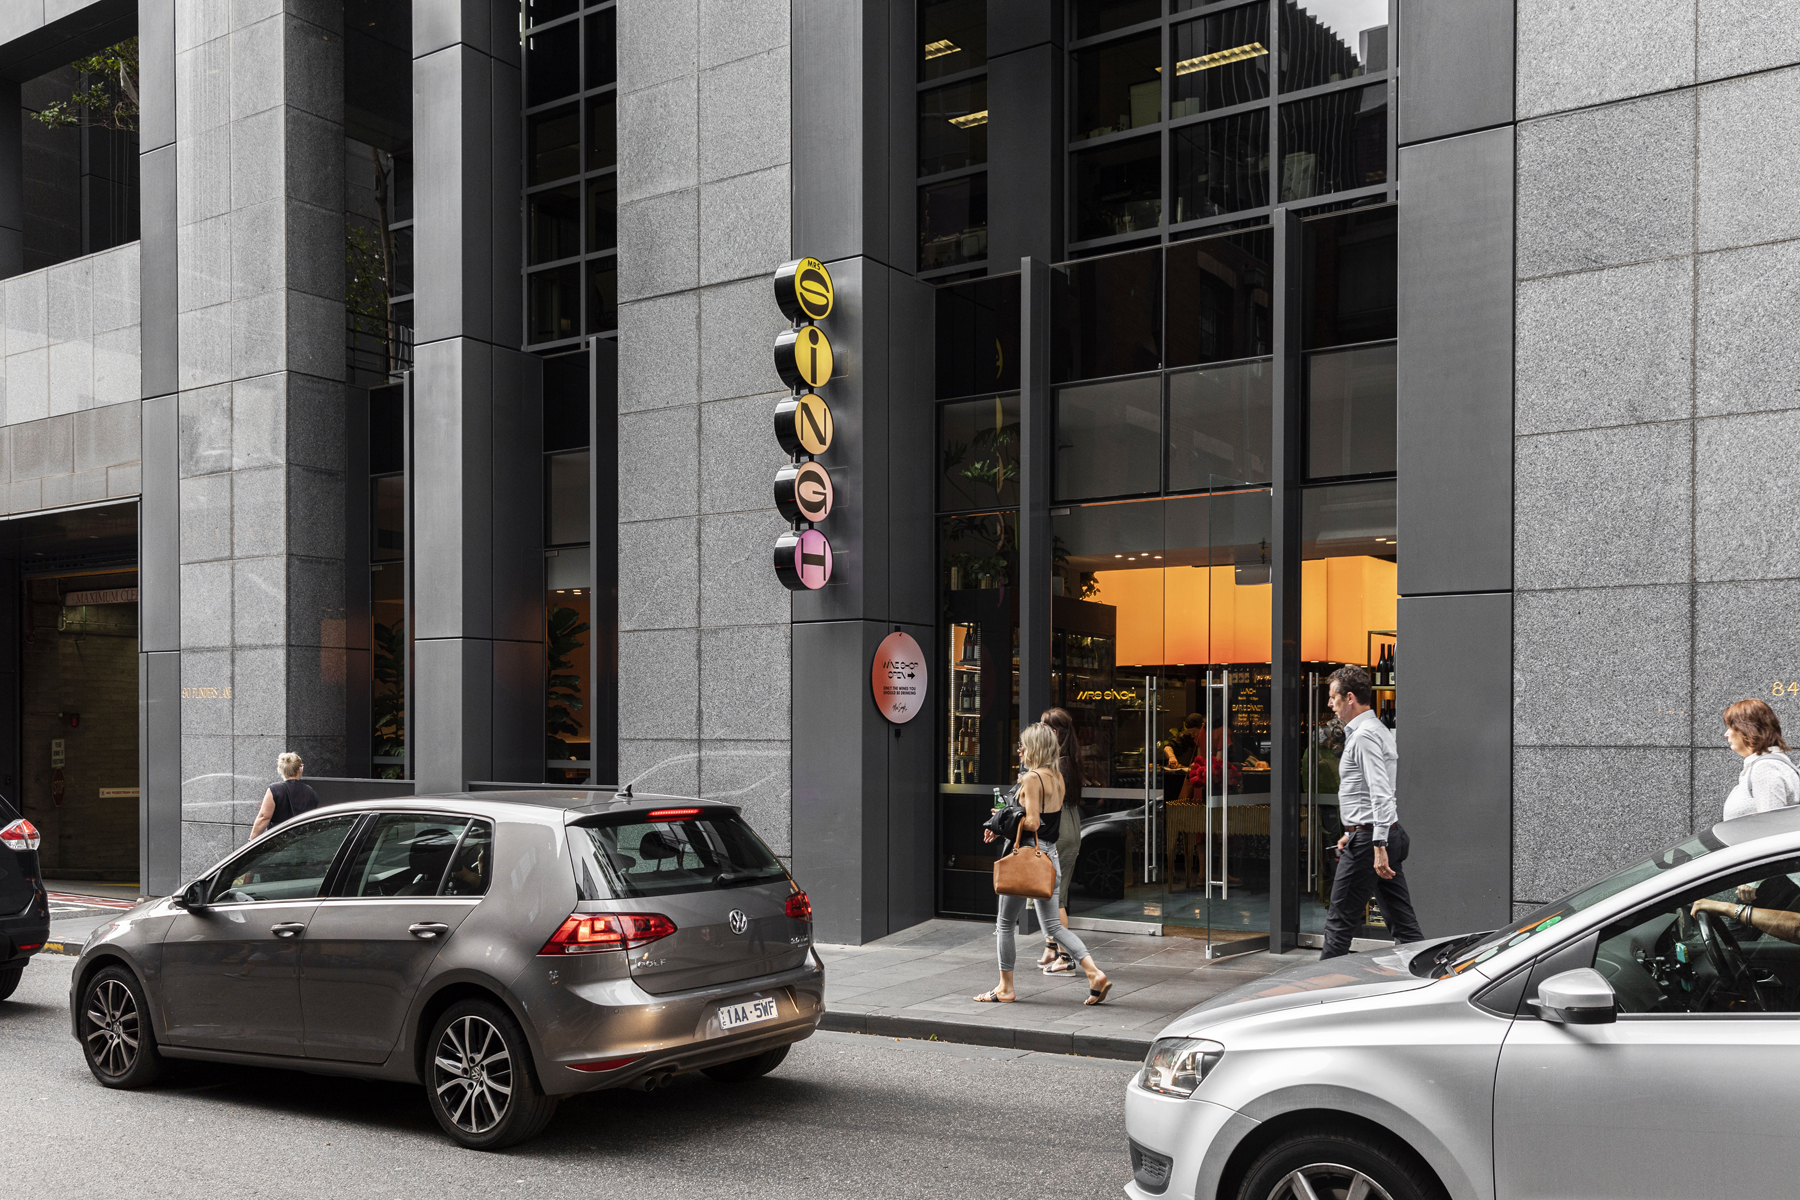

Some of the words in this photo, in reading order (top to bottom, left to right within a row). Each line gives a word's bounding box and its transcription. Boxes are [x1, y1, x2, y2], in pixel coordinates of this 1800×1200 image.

[807, 260, 821, 270] MRS
[76, 591, 119, 604] MAXIMUM
[888, 671, 906, 679] OPEN
[182, 687, 191, 698] 90
[192, 687, 218, 698] FLINDERS
[219, 686, 232, 698] LANE
[1772, 681, 1799, 696] 84
[1077, 691, 1102, 700] MRS
